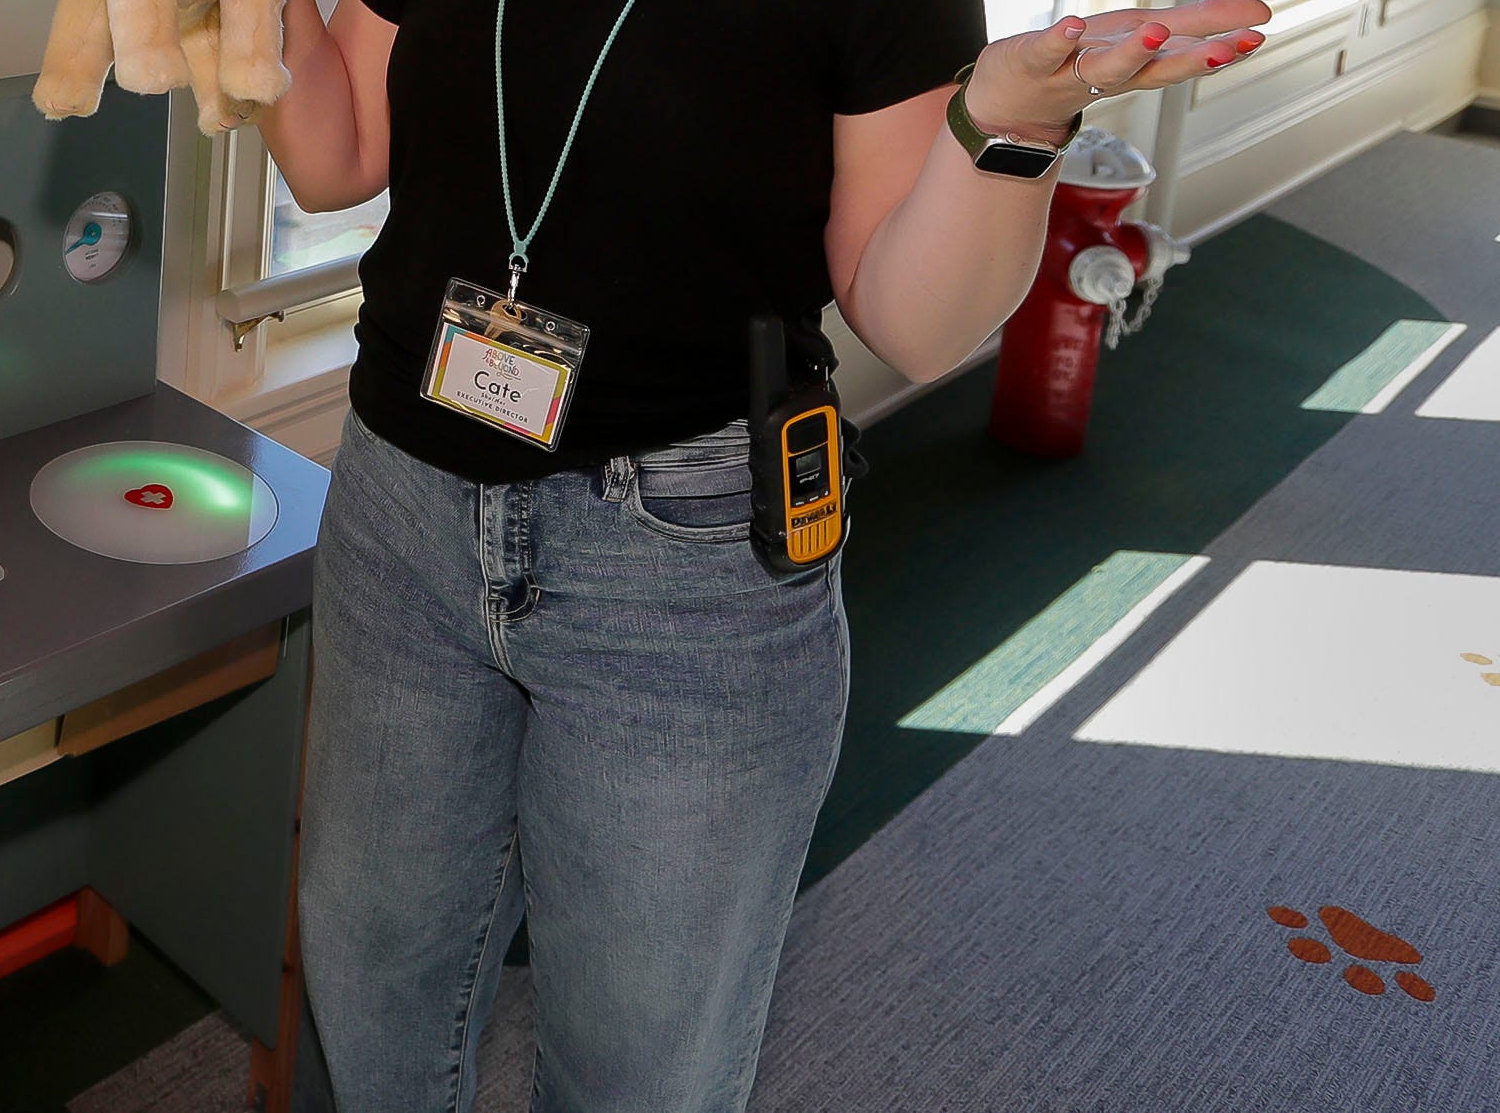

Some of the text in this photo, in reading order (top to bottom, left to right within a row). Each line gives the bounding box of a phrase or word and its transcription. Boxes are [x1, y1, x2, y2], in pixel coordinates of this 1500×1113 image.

[482, 348, 515, 365] ABOVE
[474, 371, 521, 402] Cate
[457, 391, 528, 423] EXECUTIVE DIRECTOR
